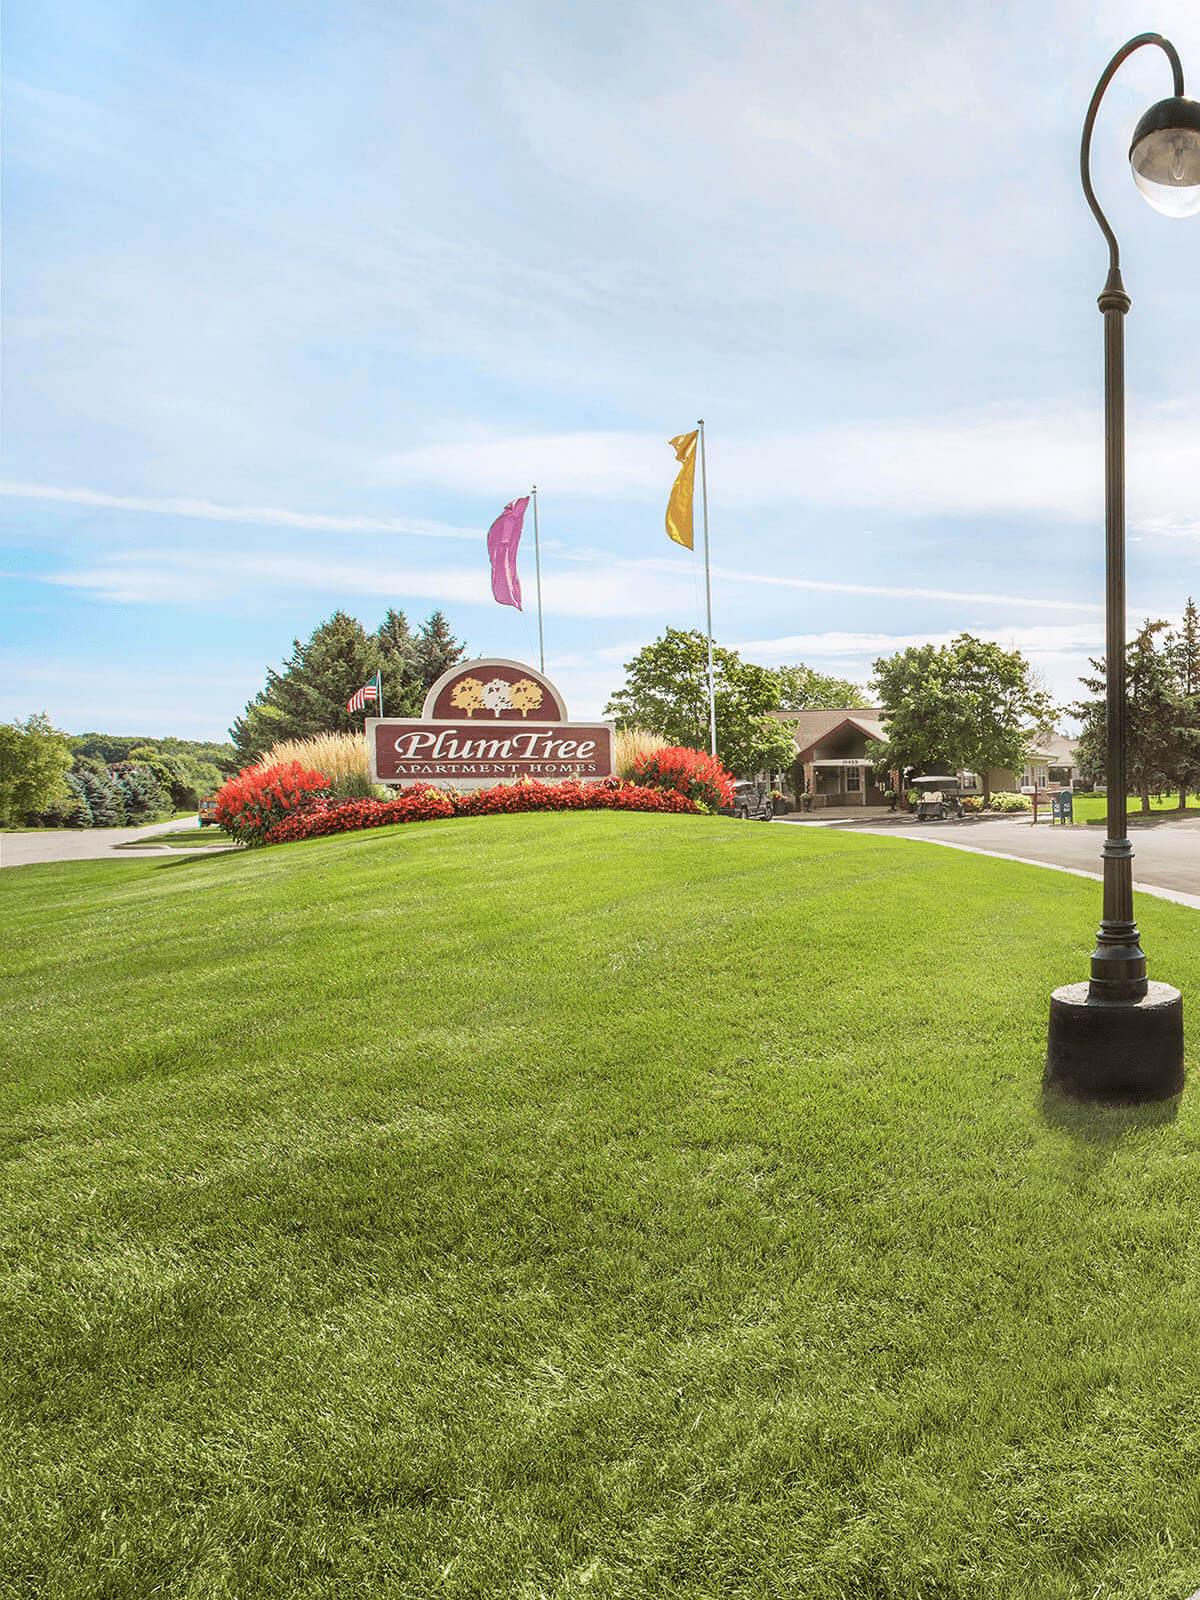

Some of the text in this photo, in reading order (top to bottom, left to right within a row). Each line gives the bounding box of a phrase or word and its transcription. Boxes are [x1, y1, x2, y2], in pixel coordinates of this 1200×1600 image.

[394, 729, 596, 760] PlumTree
[395, 763, 597, 773] APARTMENT HOMES
